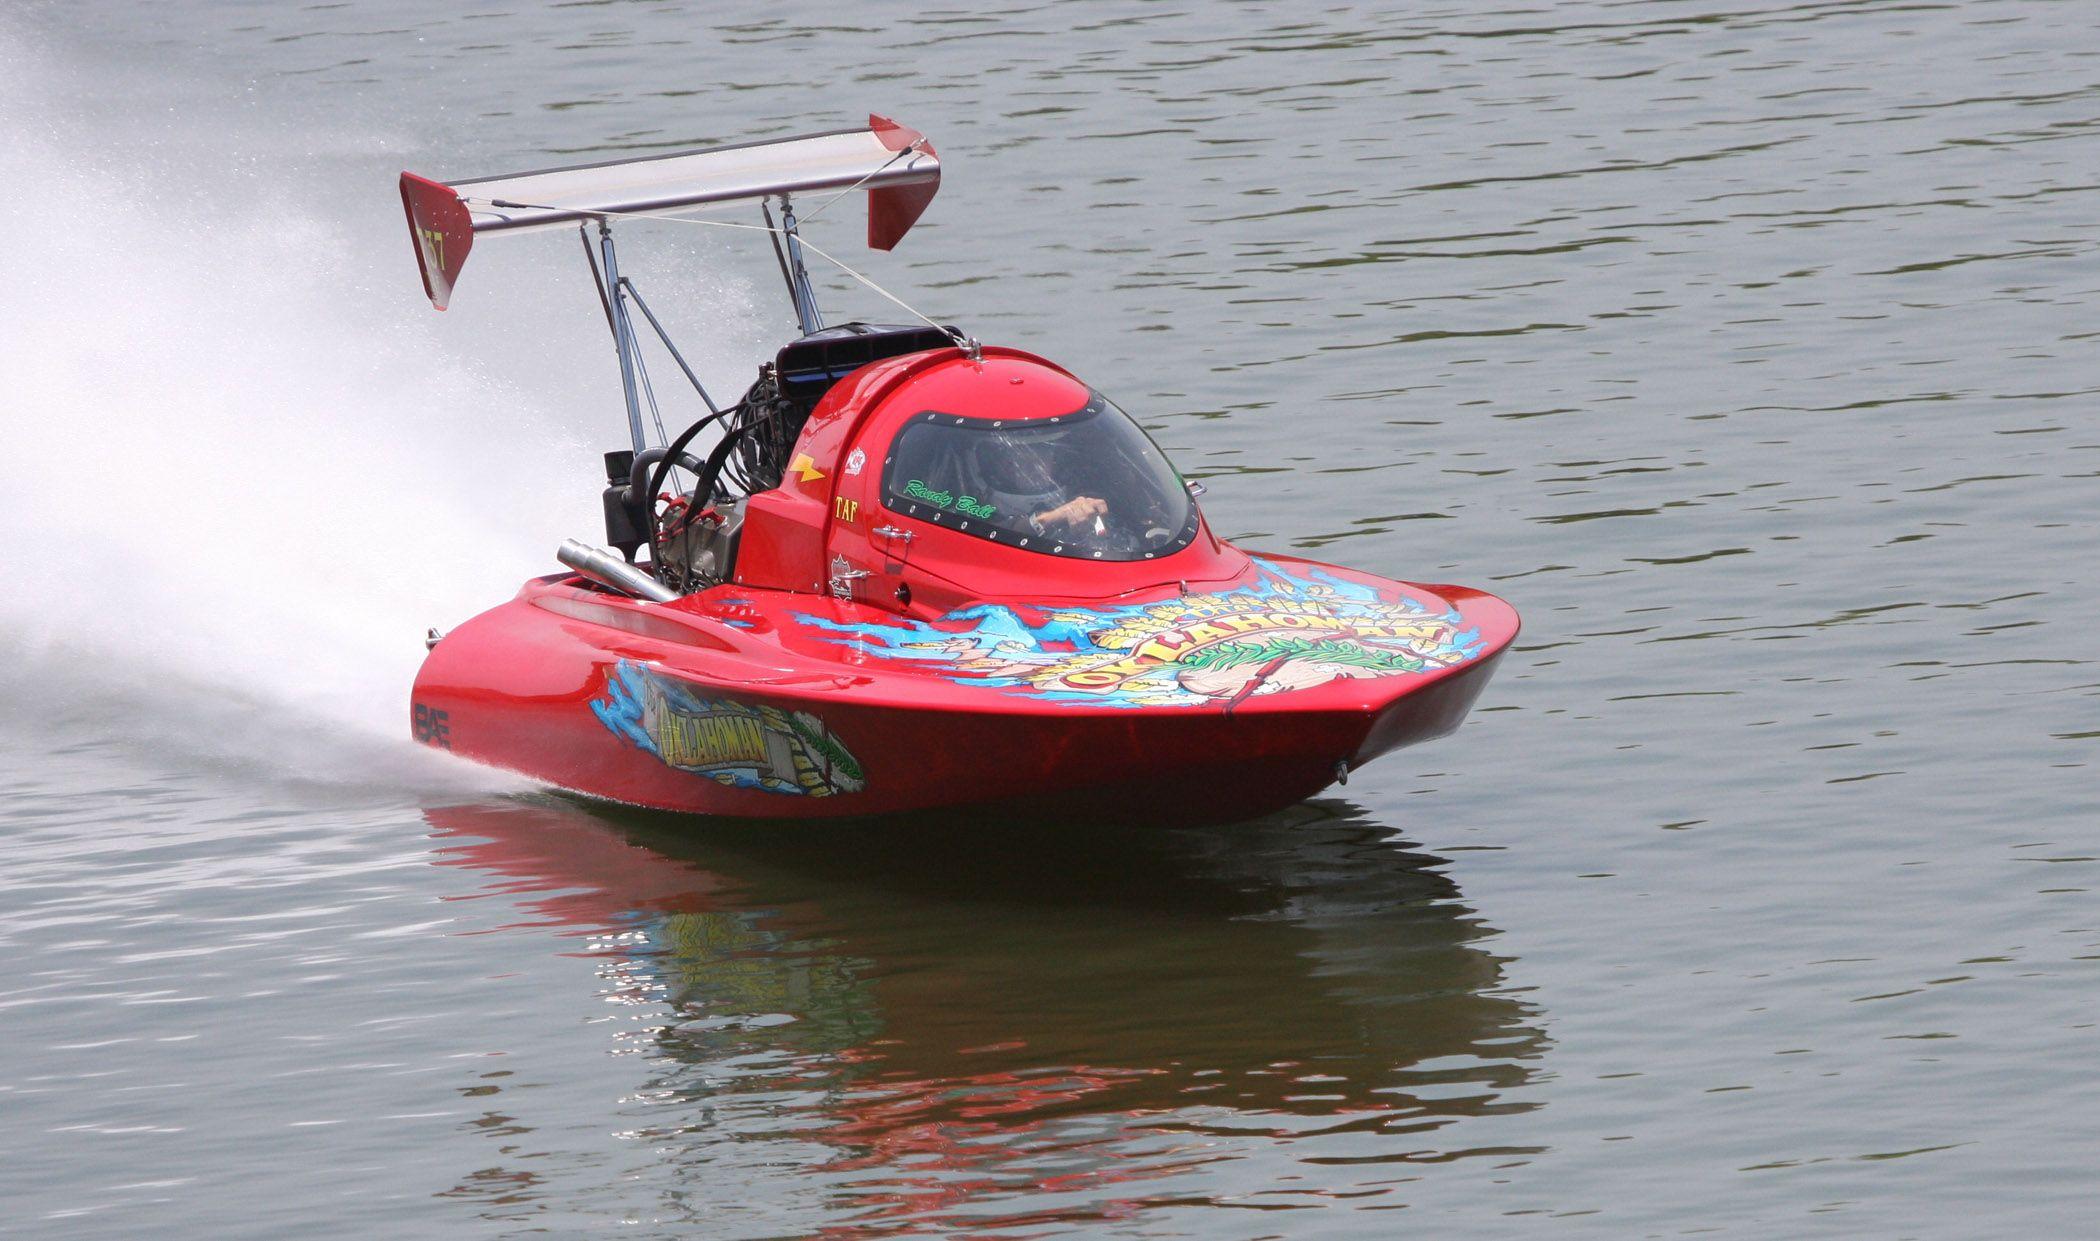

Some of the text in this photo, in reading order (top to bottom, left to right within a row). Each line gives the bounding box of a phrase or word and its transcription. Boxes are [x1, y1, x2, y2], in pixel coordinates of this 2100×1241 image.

[835, 496, 858, 523] TAF
[903, 479, 998, 519] Randy Ball
[1066, 613, 1440, 688] OKLAHOMAN
[660, 697, 768, 766] OKLAHOMAN
